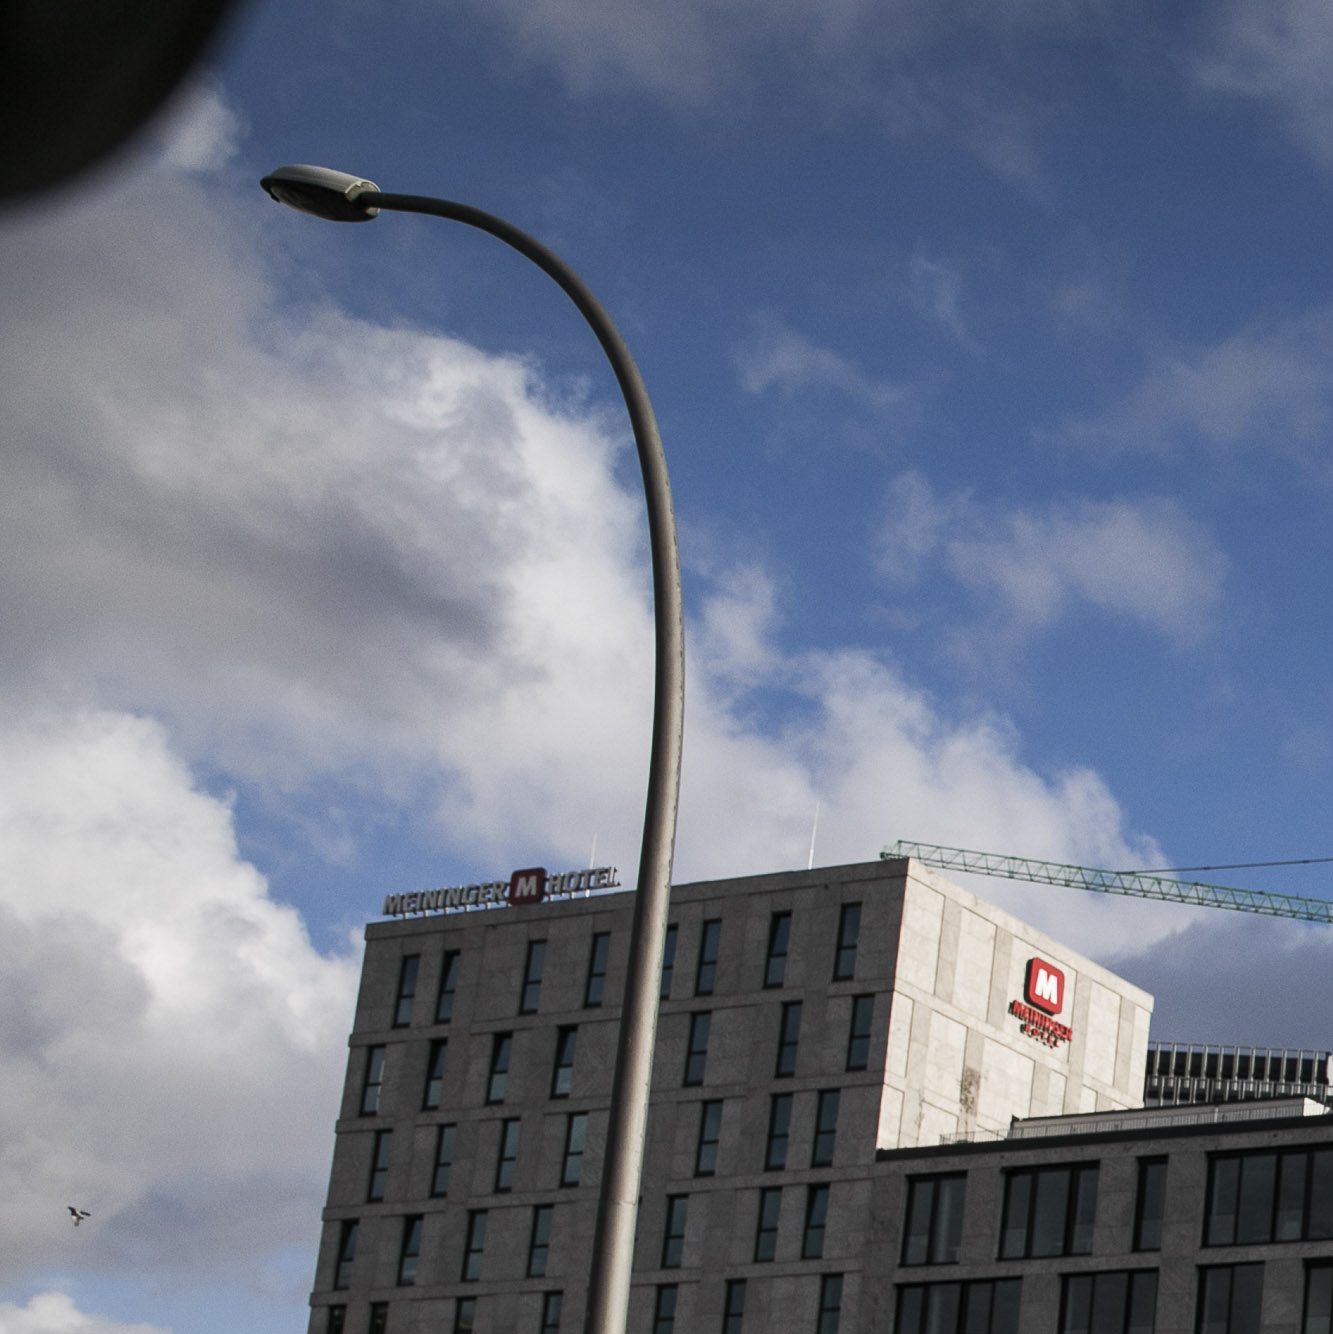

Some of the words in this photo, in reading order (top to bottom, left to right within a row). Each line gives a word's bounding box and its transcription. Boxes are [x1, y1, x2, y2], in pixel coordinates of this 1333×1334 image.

[382, 880, 507, 917] MEININGER
[515, 874, 538, 898] M
[546, 866, 620, 895] HOTEL
[1034, 967, 1058, 1006] M
